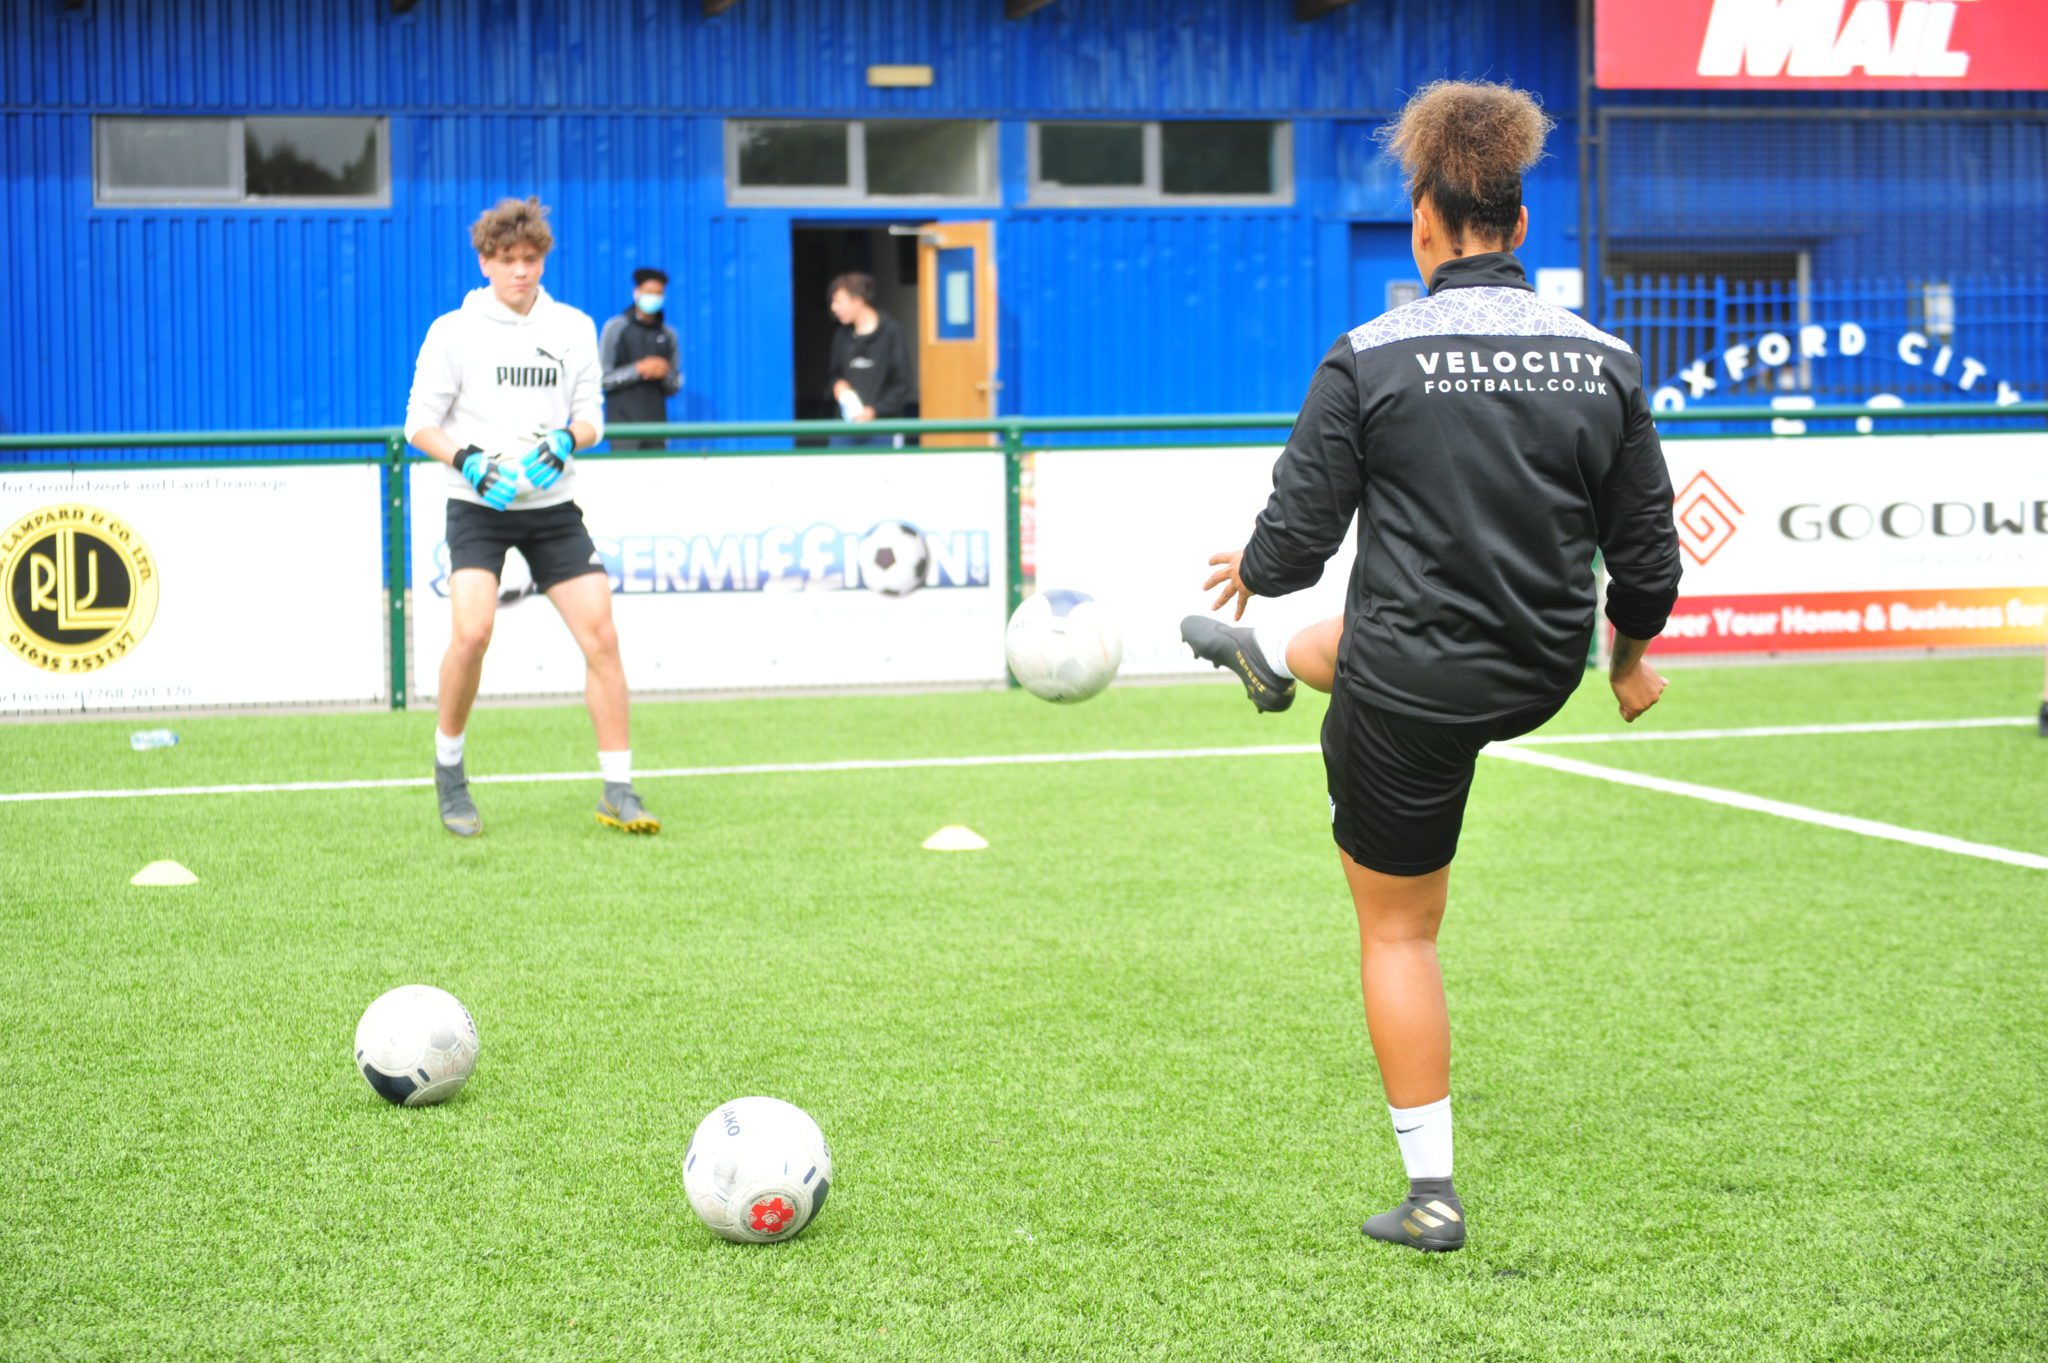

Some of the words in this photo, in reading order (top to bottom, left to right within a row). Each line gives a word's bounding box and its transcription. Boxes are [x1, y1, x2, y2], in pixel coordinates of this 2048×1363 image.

[1696, 0, 1971, 77] MAIL
[496, 366, 558, 388] PUMA
[1415, 350, 1605, 376] VELOCITY
[1652, 322, 1867, 412] OXFORD
[1897, 331, 2021, 407] CITY
[1424, 378, 1607, 396] FOOTBALL.CO.UK
[2, 508, 84, 553] LAMPARD
[1712, 607, 1779, 636] Your
[1781, 605, 1861, 634] Home
[1863, 602, 1888, 632] &
[1889, 602, 2004, 630] Business
